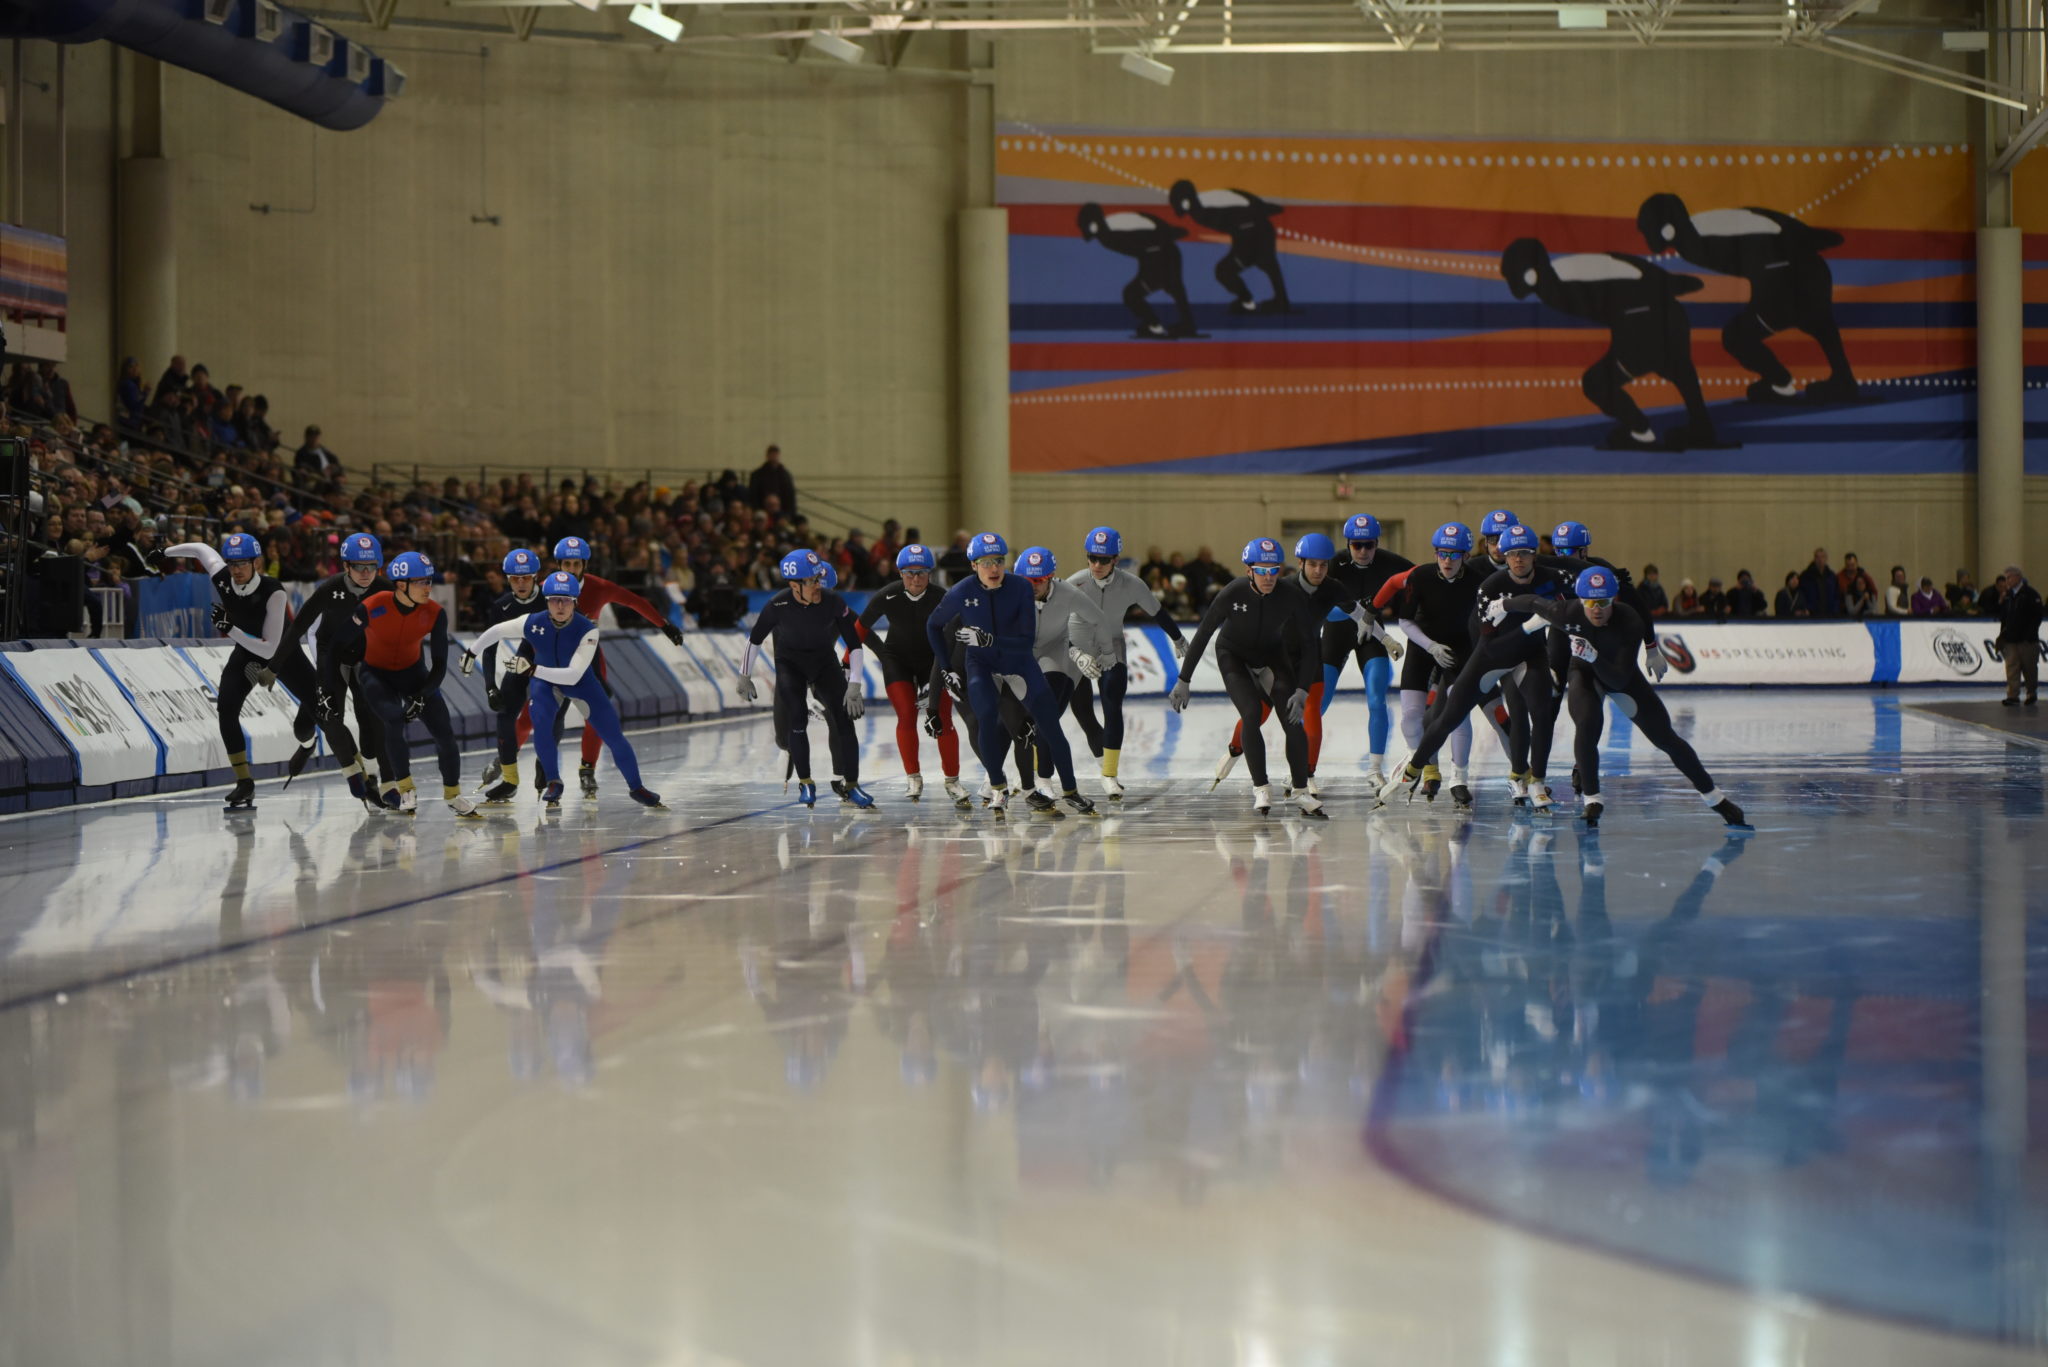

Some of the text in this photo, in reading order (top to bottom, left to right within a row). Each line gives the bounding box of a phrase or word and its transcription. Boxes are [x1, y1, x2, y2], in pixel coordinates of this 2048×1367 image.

[392, 561, 409, 578] 69
[783, 561, 798, 576] 56
[1941, 641, 1969, 656] CORE
